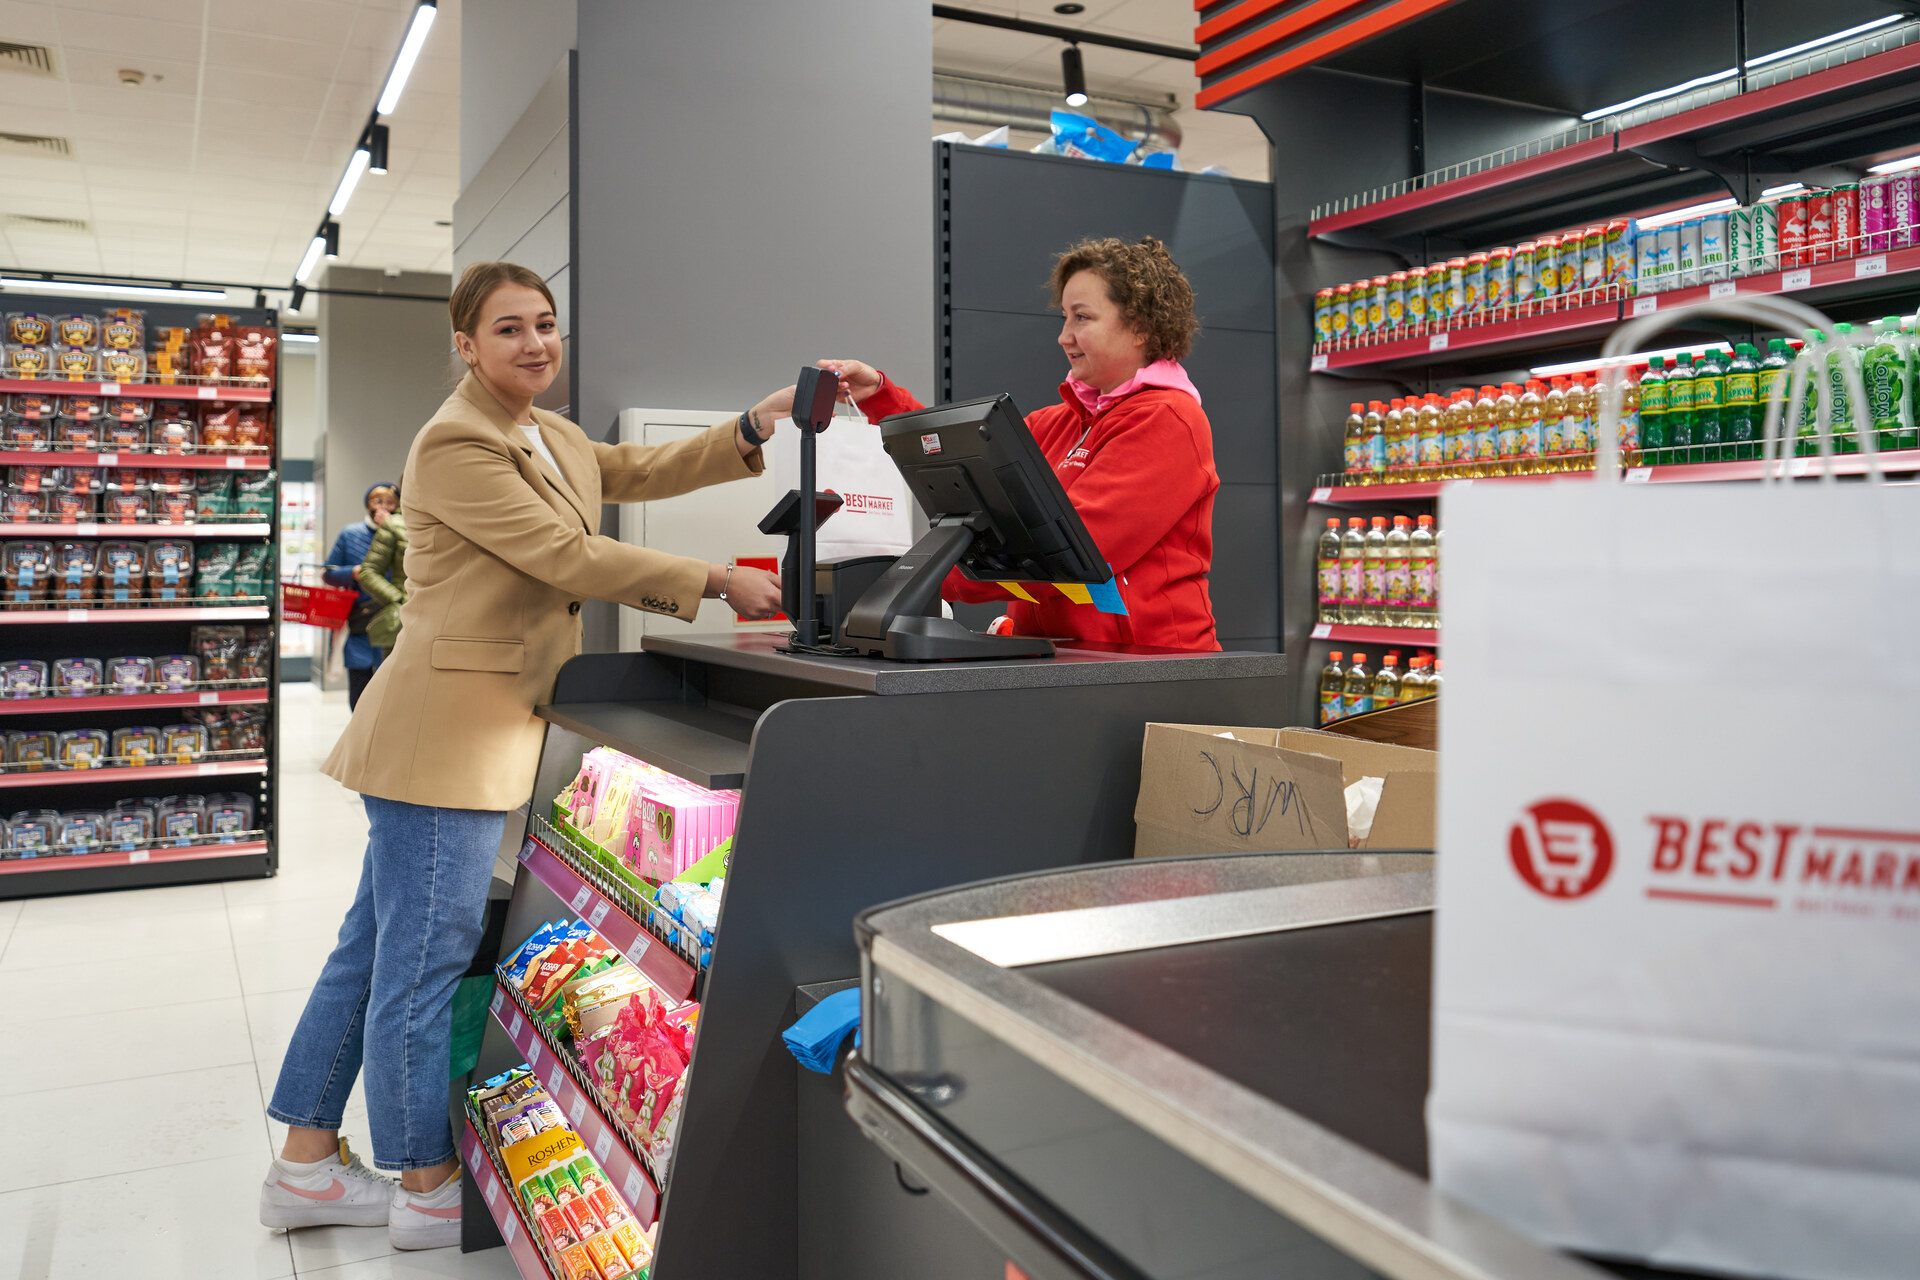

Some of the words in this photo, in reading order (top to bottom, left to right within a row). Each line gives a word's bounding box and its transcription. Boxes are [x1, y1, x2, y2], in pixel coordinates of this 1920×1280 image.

[1895, 180, 1909, 242] KOMODO
[844, 493, 867, 508] BEST
[868, 500, 893, 510] MARKET
[1645, 813, 1802, 883] BEST
[527, 1133, 577, 1166] ROSHEN
